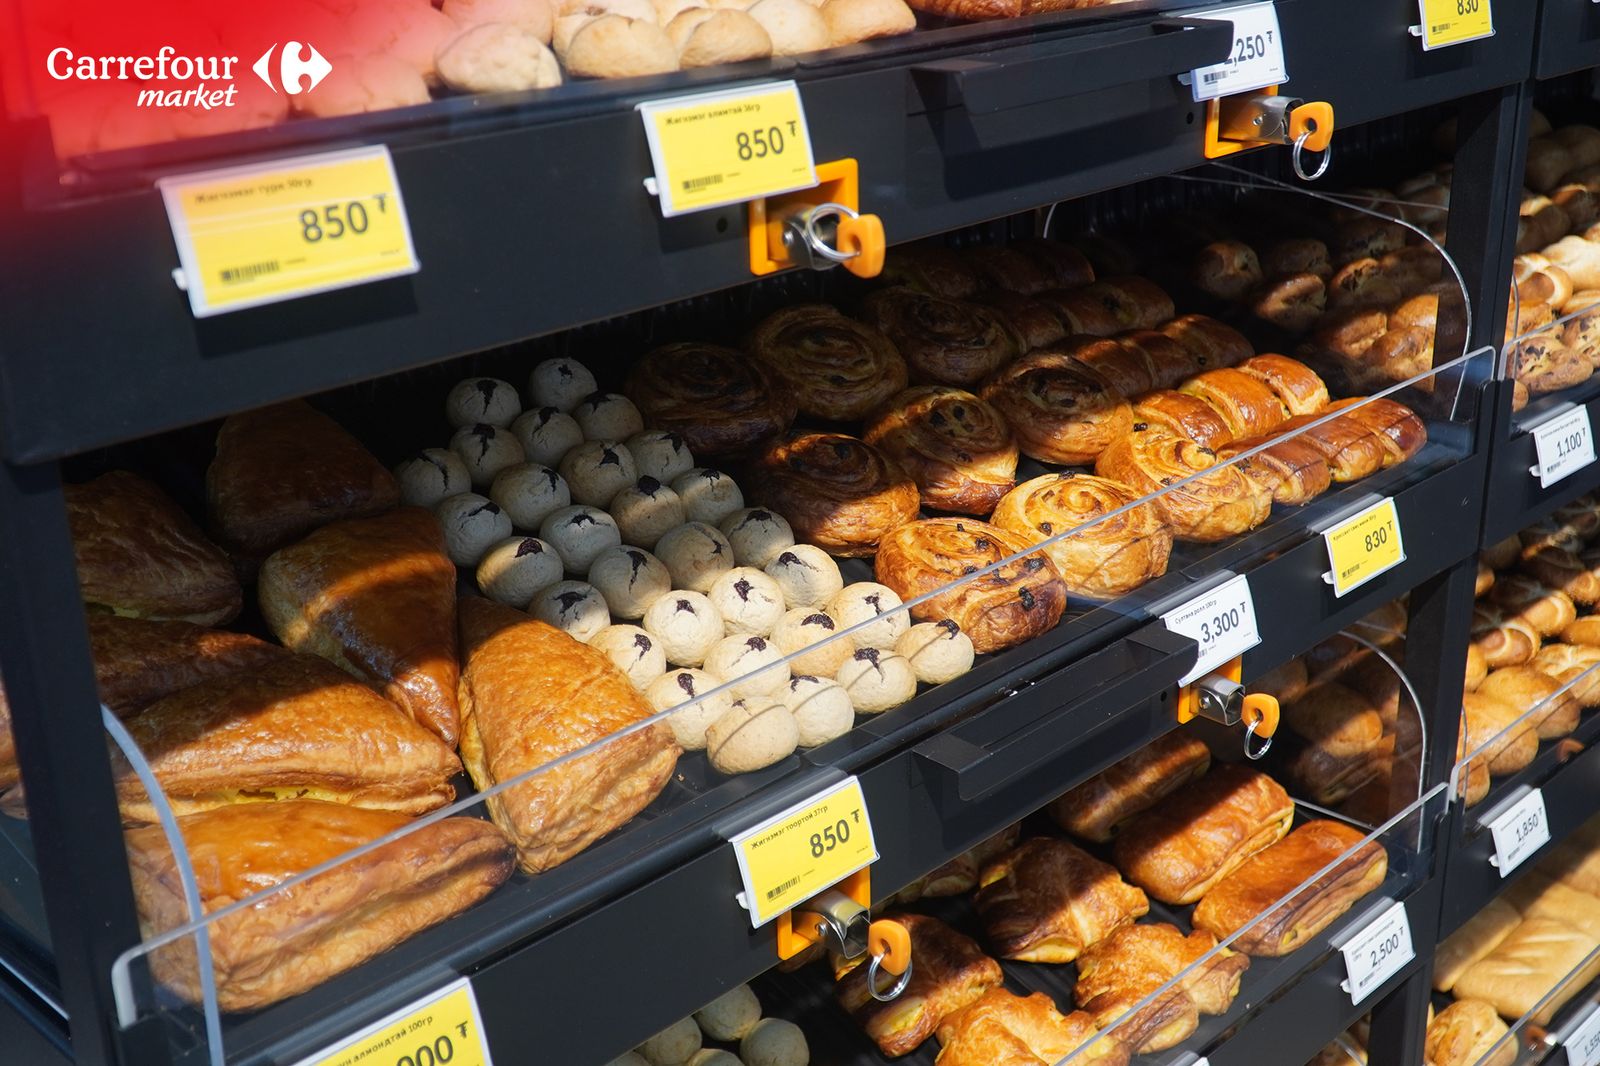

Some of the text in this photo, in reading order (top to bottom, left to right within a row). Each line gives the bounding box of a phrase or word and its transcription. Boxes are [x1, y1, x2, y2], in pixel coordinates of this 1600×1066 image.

[1457, 0, 1478, 15] 830
[1224, 34, 1265, 67] ,250
[735, 126, 785, 161] 850
[299, 201, 369, 244] 850
[1556, 431, 1582, 458] 1,100
[1364, 526, 1387, 553] 830
[1201, 608, 1239, 643] 3,300
[809, 818, 850, 858] 850
[1370, 933, 1399, 968] 2,500
